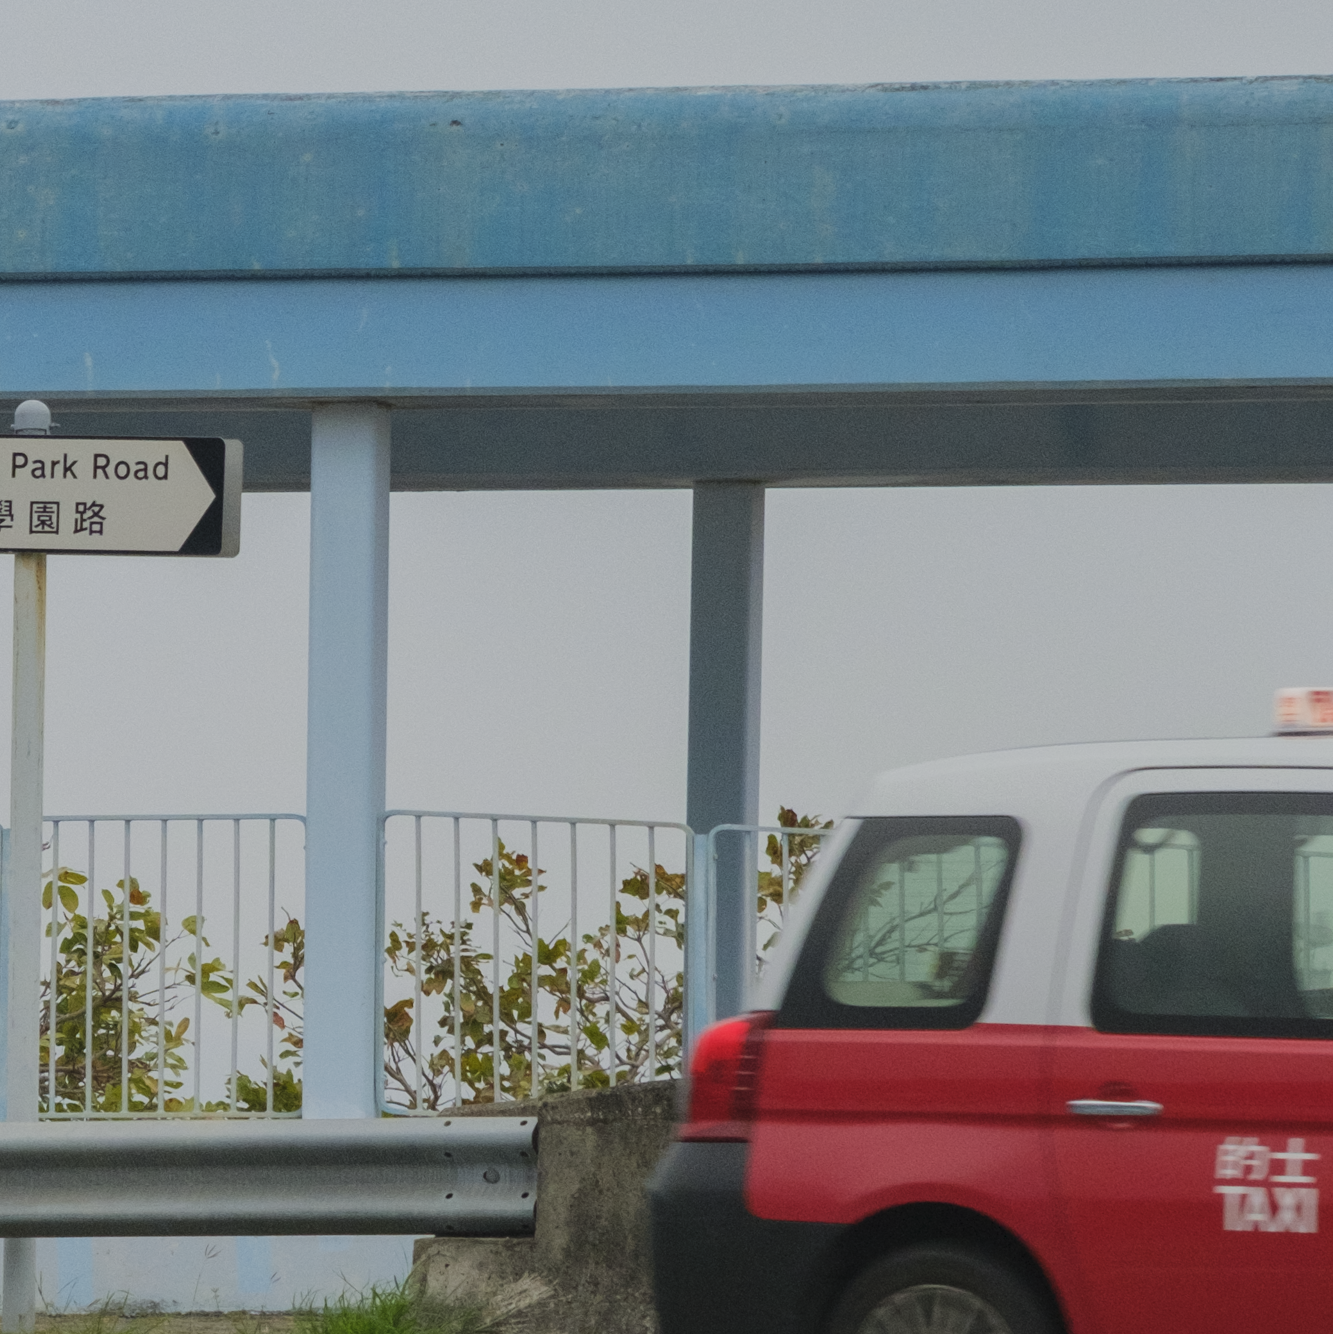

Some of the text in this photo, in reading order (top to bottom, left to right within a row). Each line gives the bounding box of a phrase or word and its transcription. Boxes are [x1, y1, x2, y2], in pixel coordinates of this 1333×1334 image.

[11, 452, 78, 480] Park
[92, 453, 170, 481] Road
[1214, 1136, 1321, 1183] 的士
[1213, 1185, 1320, 1234] TAXI
